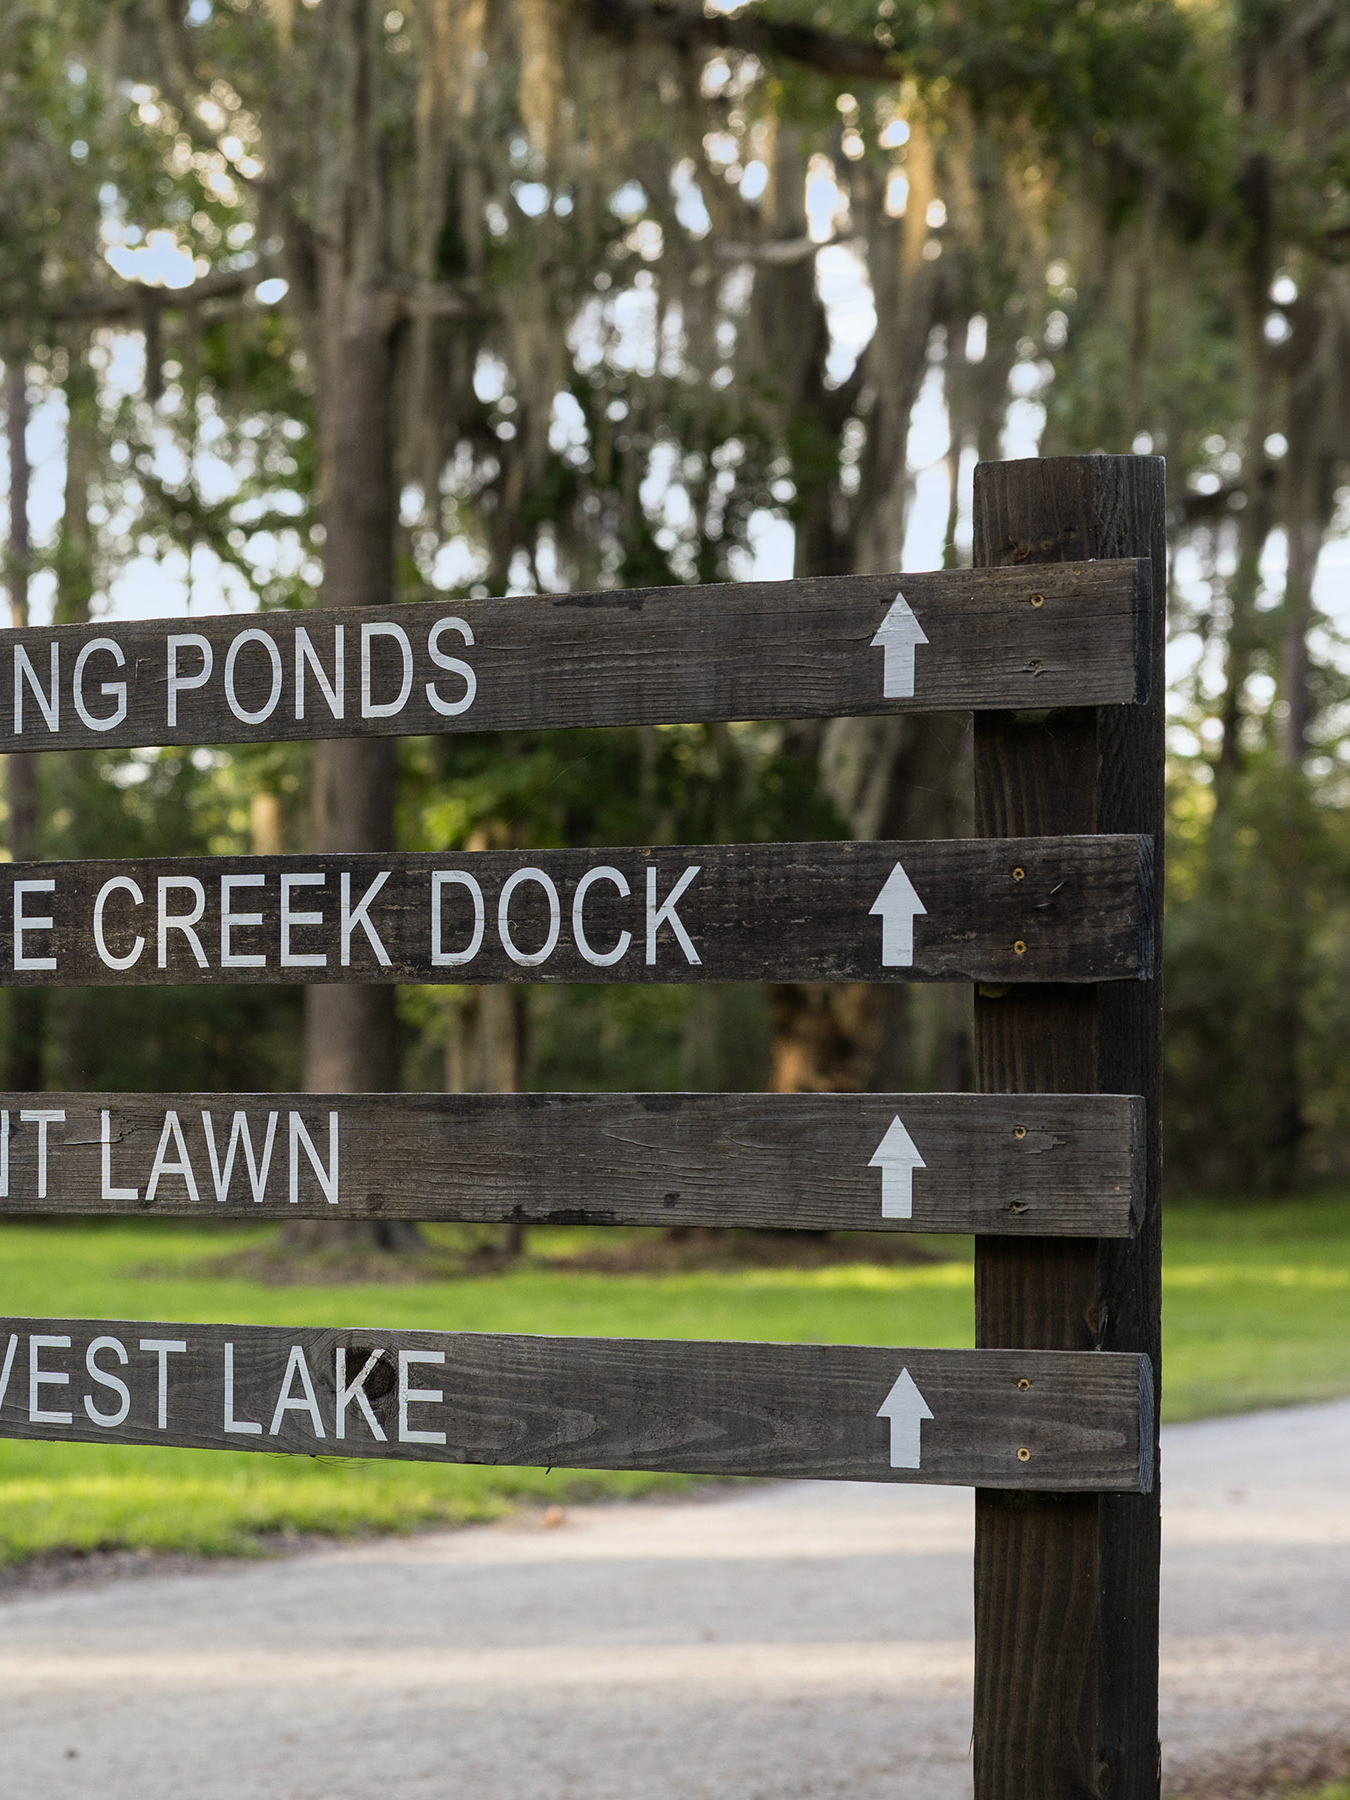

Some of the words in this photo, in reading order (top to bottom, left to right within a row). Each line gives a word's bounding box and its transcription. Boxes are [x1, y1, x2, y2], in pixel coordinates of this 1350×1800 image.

[166, 616, 478, 727] PONDS
[92, 870, 394, 972] CREEK
[430, 864, 704, 968] DOCK
[98, 1108, 341, 1206] LAWN
[222, 1341, 448, 1446] LAKE
